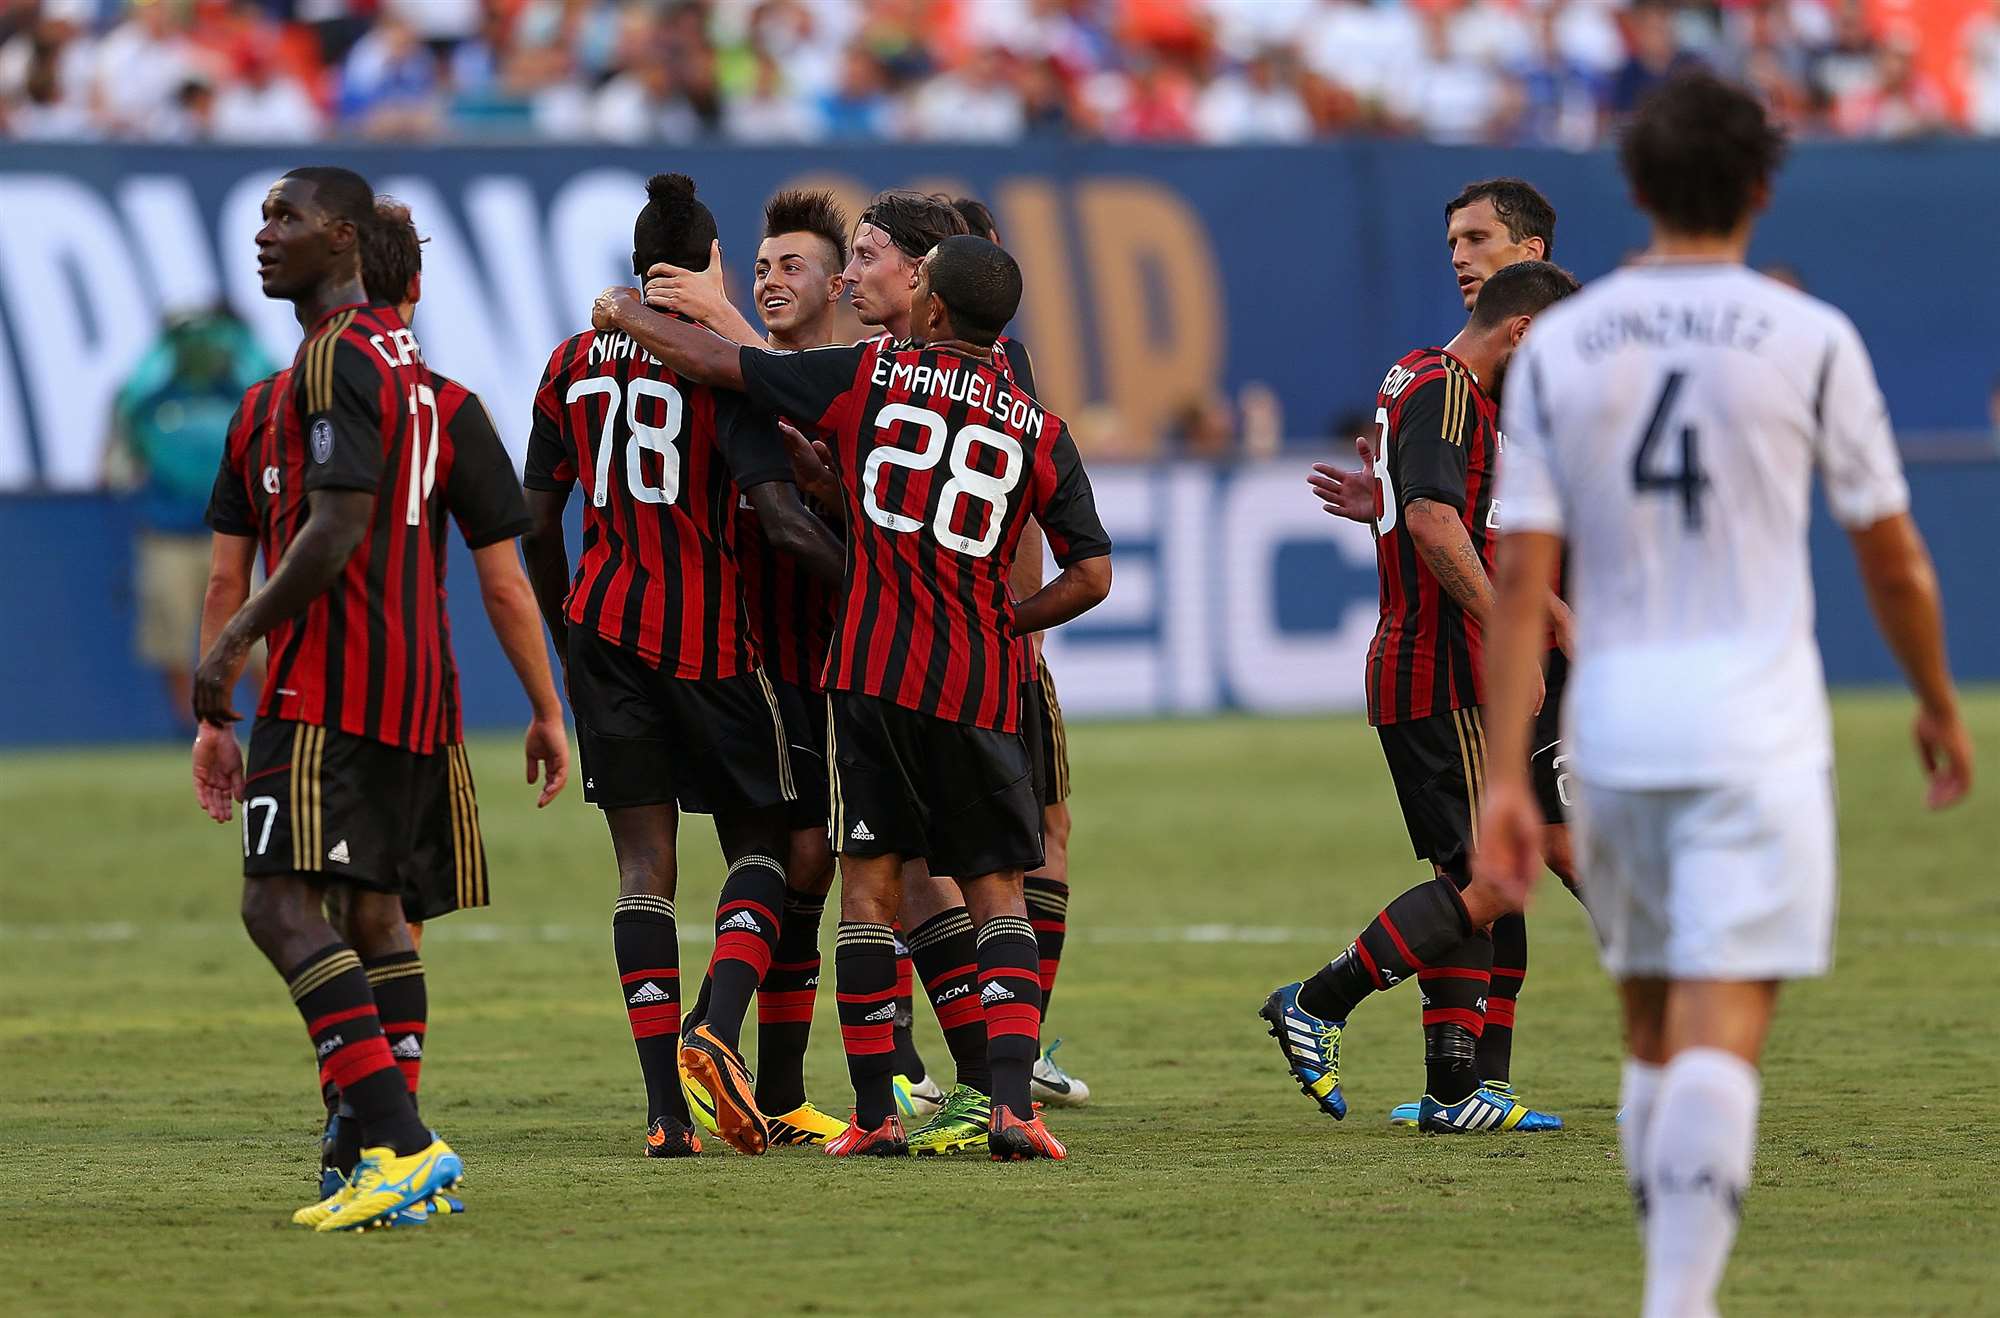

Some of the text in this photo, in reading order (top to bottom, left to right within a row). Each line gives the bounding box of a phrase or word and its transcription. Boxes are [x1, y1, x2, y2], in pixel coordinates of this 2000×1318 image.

[871, 357, 1044, 439] EMANUELSON
[406, 383, 440, 526] 17
[566, 376, 683, 508] 78
[862, 402, 1024, 558] 28
[1631, 368, 1712, 534] 4
[242, 796, 278, 857] 17
[720, 919, 762, 933] adidas
[629, 992, 670, 1004] adidas
[936, 984, 969, 1004] ACM
